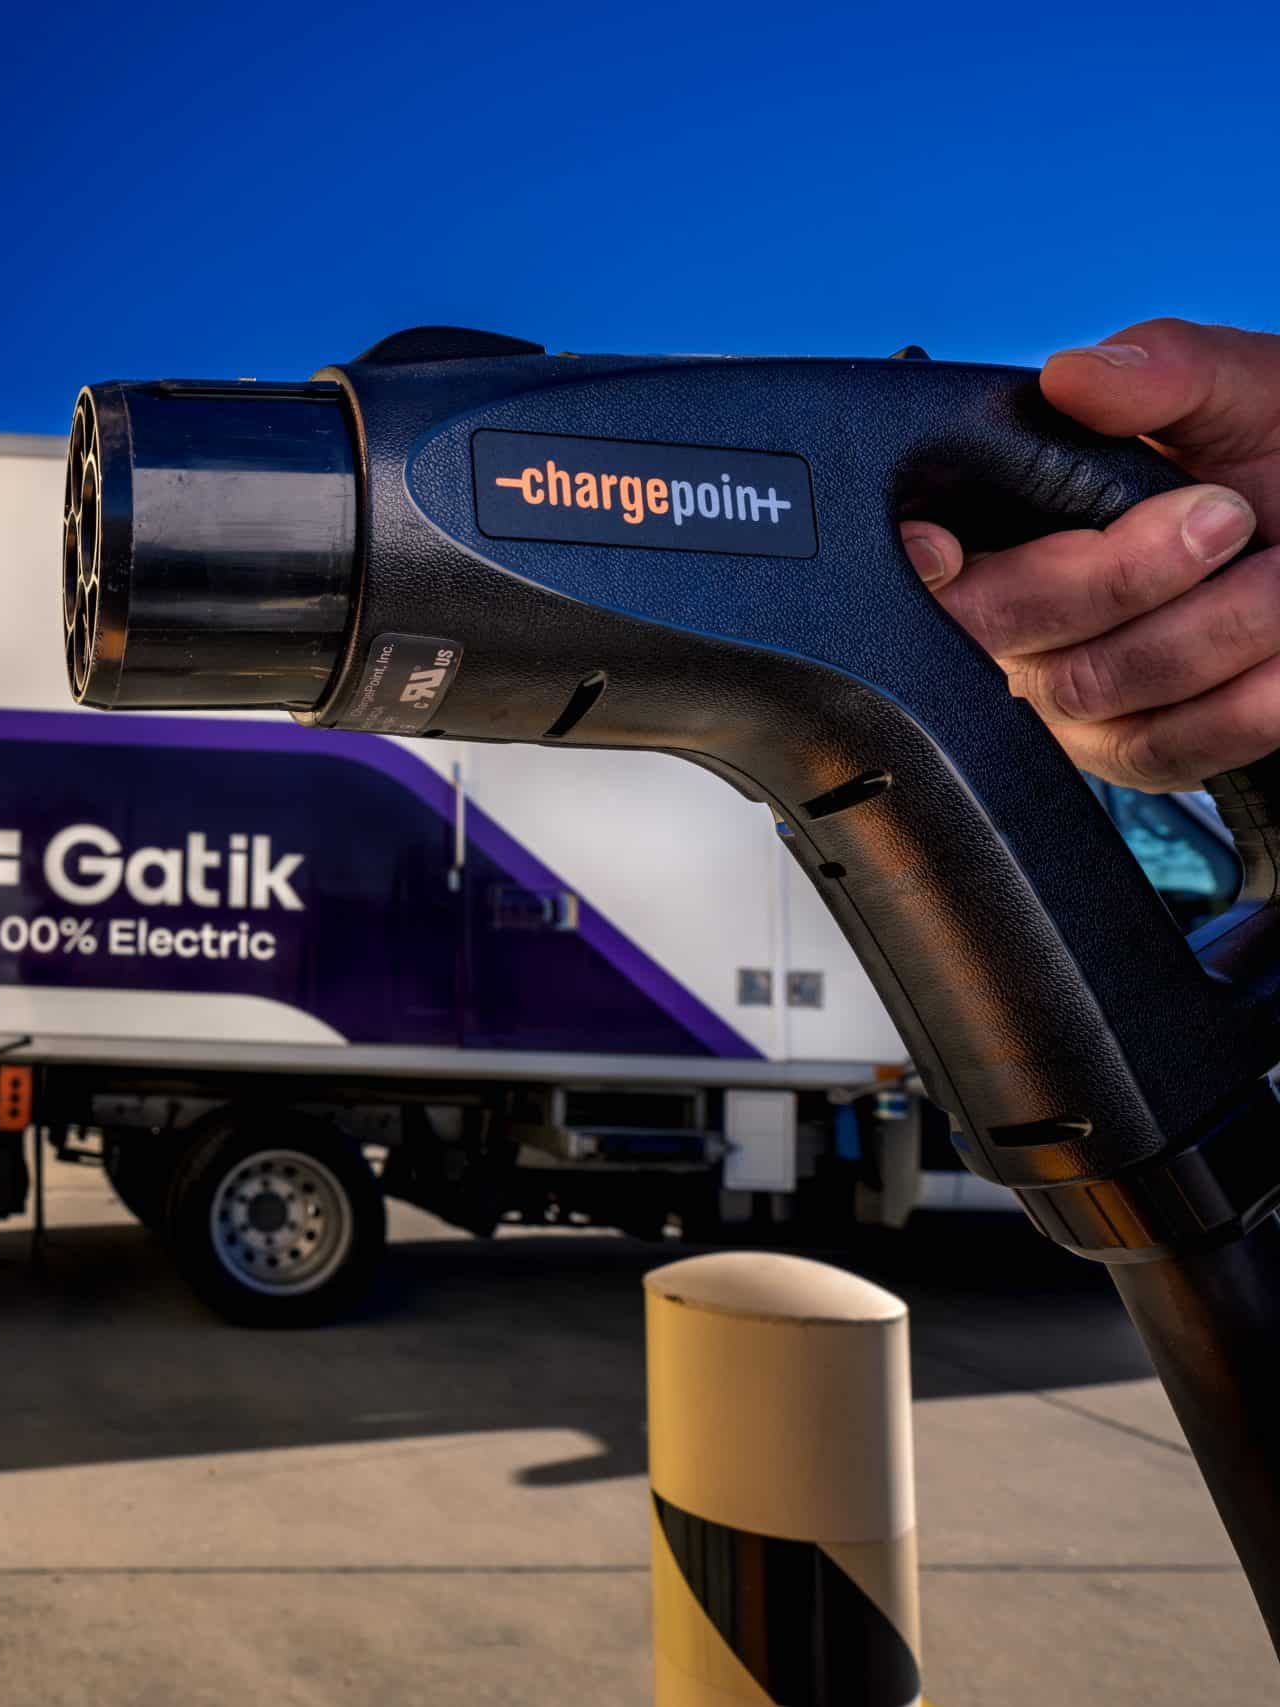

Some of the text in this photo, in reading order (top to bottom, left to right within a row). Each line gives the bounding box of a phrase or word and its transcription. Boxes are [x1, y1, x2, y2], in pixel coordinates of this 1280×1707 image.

[495, 459, 792, 526] chargepoint
[375, 643, 395, 664] Inc.
[43, 823, 306, 911] Gatik
[108, 917, 277, 961] Electric
